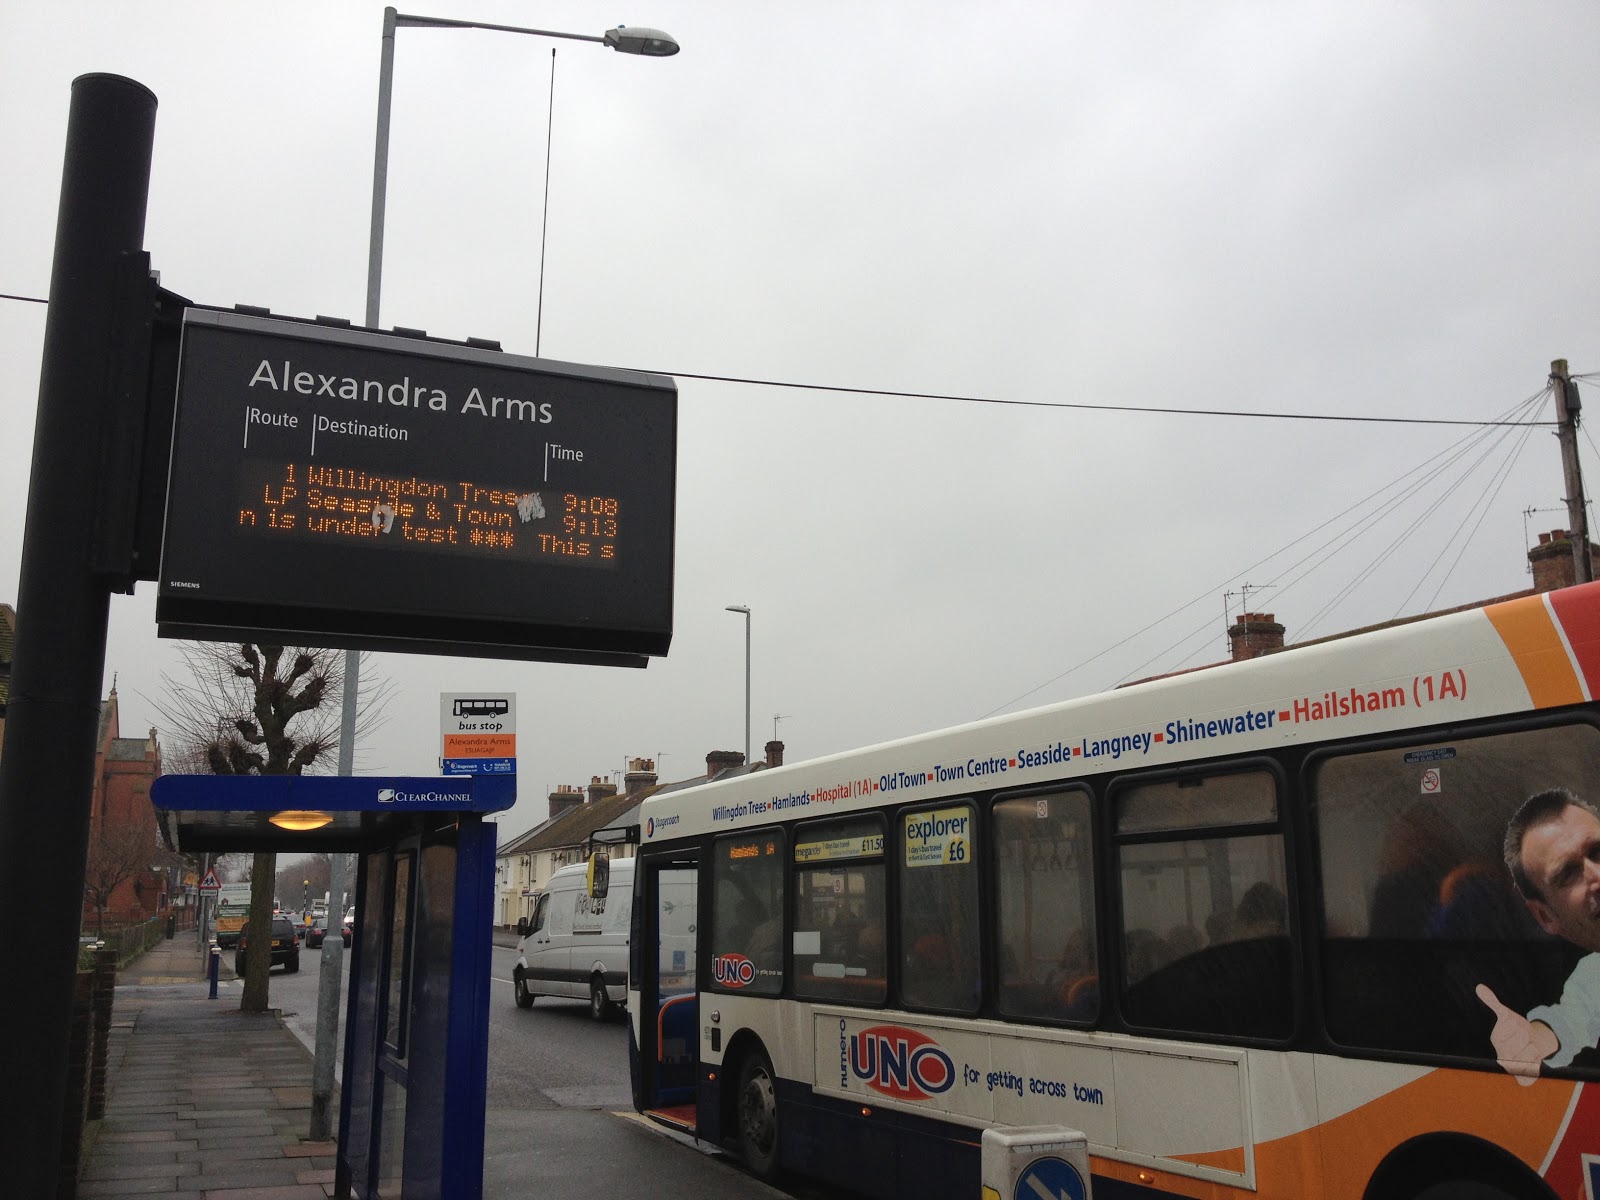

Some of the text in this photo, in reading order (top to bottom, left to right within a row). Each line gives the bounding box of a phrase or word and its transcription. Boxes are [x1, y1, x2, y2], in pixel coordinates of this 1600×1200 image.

[248, 359, 553, 424] Alexandra Arms
[250, 407, 584, 462] Route Destination Time
[264, 484, 297, 505] LP
[426, 501, 441, 520] &
[453, 503, 512, 527] Town
[563, 515, 617, 537] 9:13
[286, 463, 295, 483] 1
[308, 466, 447, 499] Willingdon
[563, 493, 618, 516] 9:08
[268, 508, 296, 529] is
[402, 521, 458, 545] test
[538, 533, 590, 556] This
[170, 581, 200, 589] SIEMENS
[448, 738, 511, 746] Alexandra Arms
[458, 720, 503, 733] bus stop
[713, 668, 1467, 822] Willingdon Trees Hamlands Hospital (1A) Old Town Town Centre Seaside Langney Shinewater Hailsham (1A)
[655, 814, 680, 830] Stagecoach
[907, 814, 968, 845] explorer
[862, 838, 884, 851] £11.50
[949, 840, 965, 862] £6
[714, 957, 756, 985] UNO
[839, 1018, 848, 1089] numero
[850, 1033, 956, 1095] UNO
[963, 1063, 1104, 1106] for getting across town
